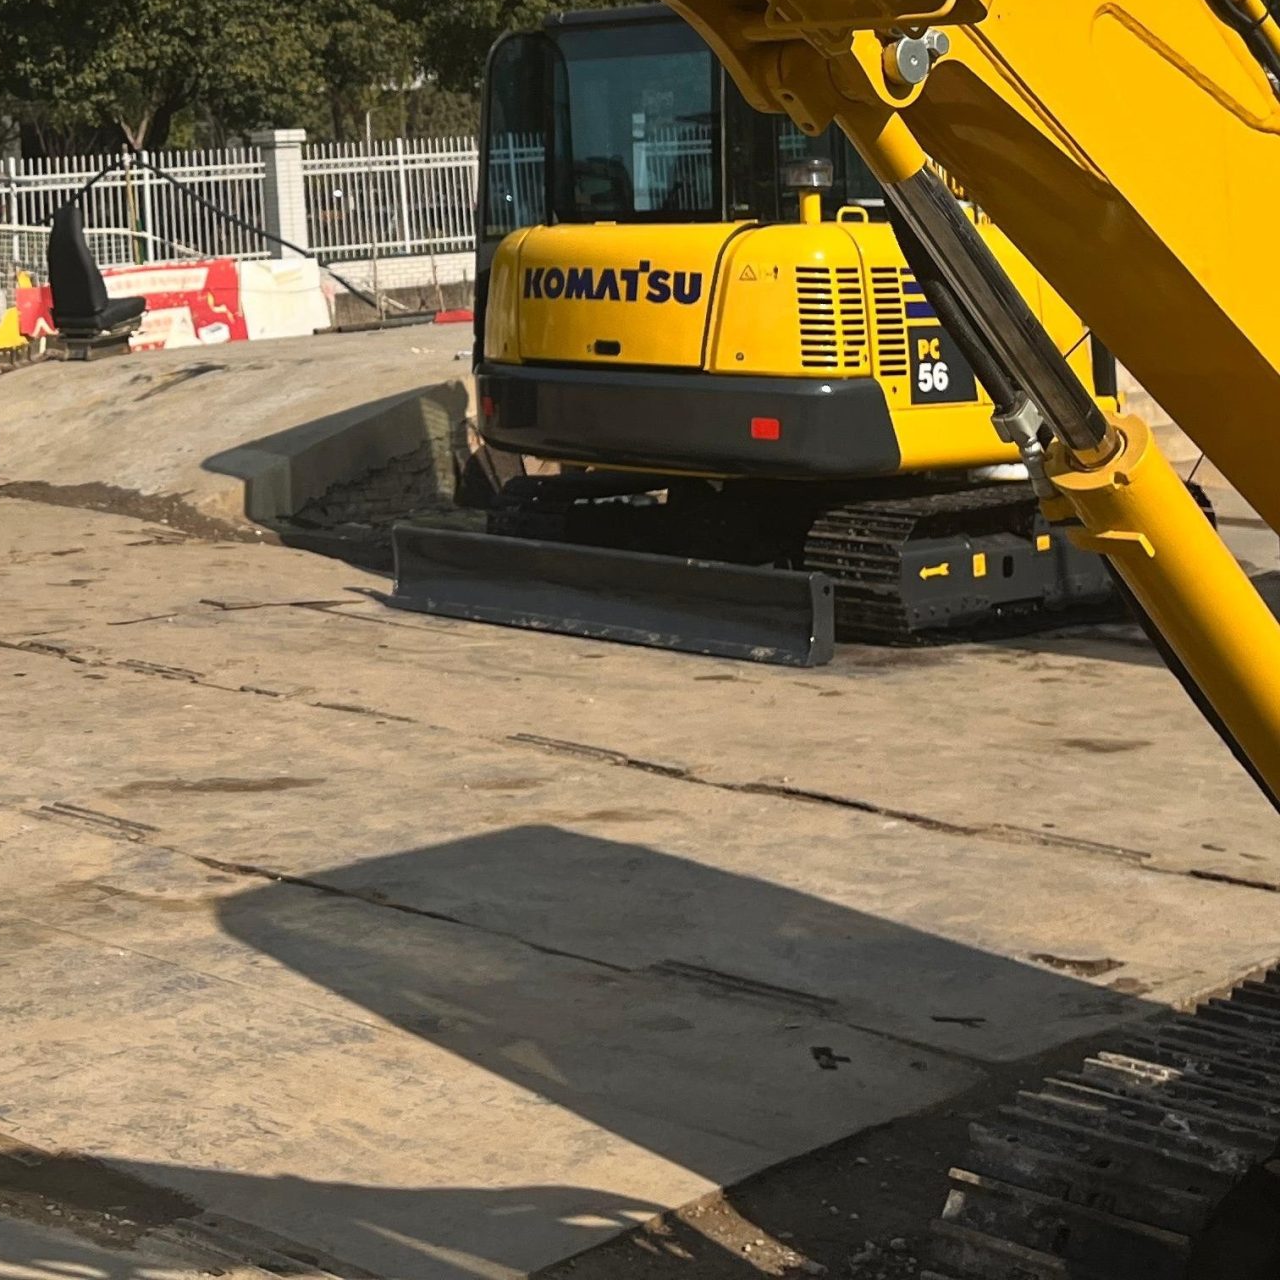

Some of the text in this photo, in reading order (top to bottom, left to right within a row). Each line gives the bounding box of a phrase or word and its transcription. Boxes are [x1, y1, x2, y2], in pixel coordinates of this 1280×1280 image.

[523, 260, 703, 305] KOMATSU
[917, 337, 941, 361] PC
[918, 361, 950, 393] 56
